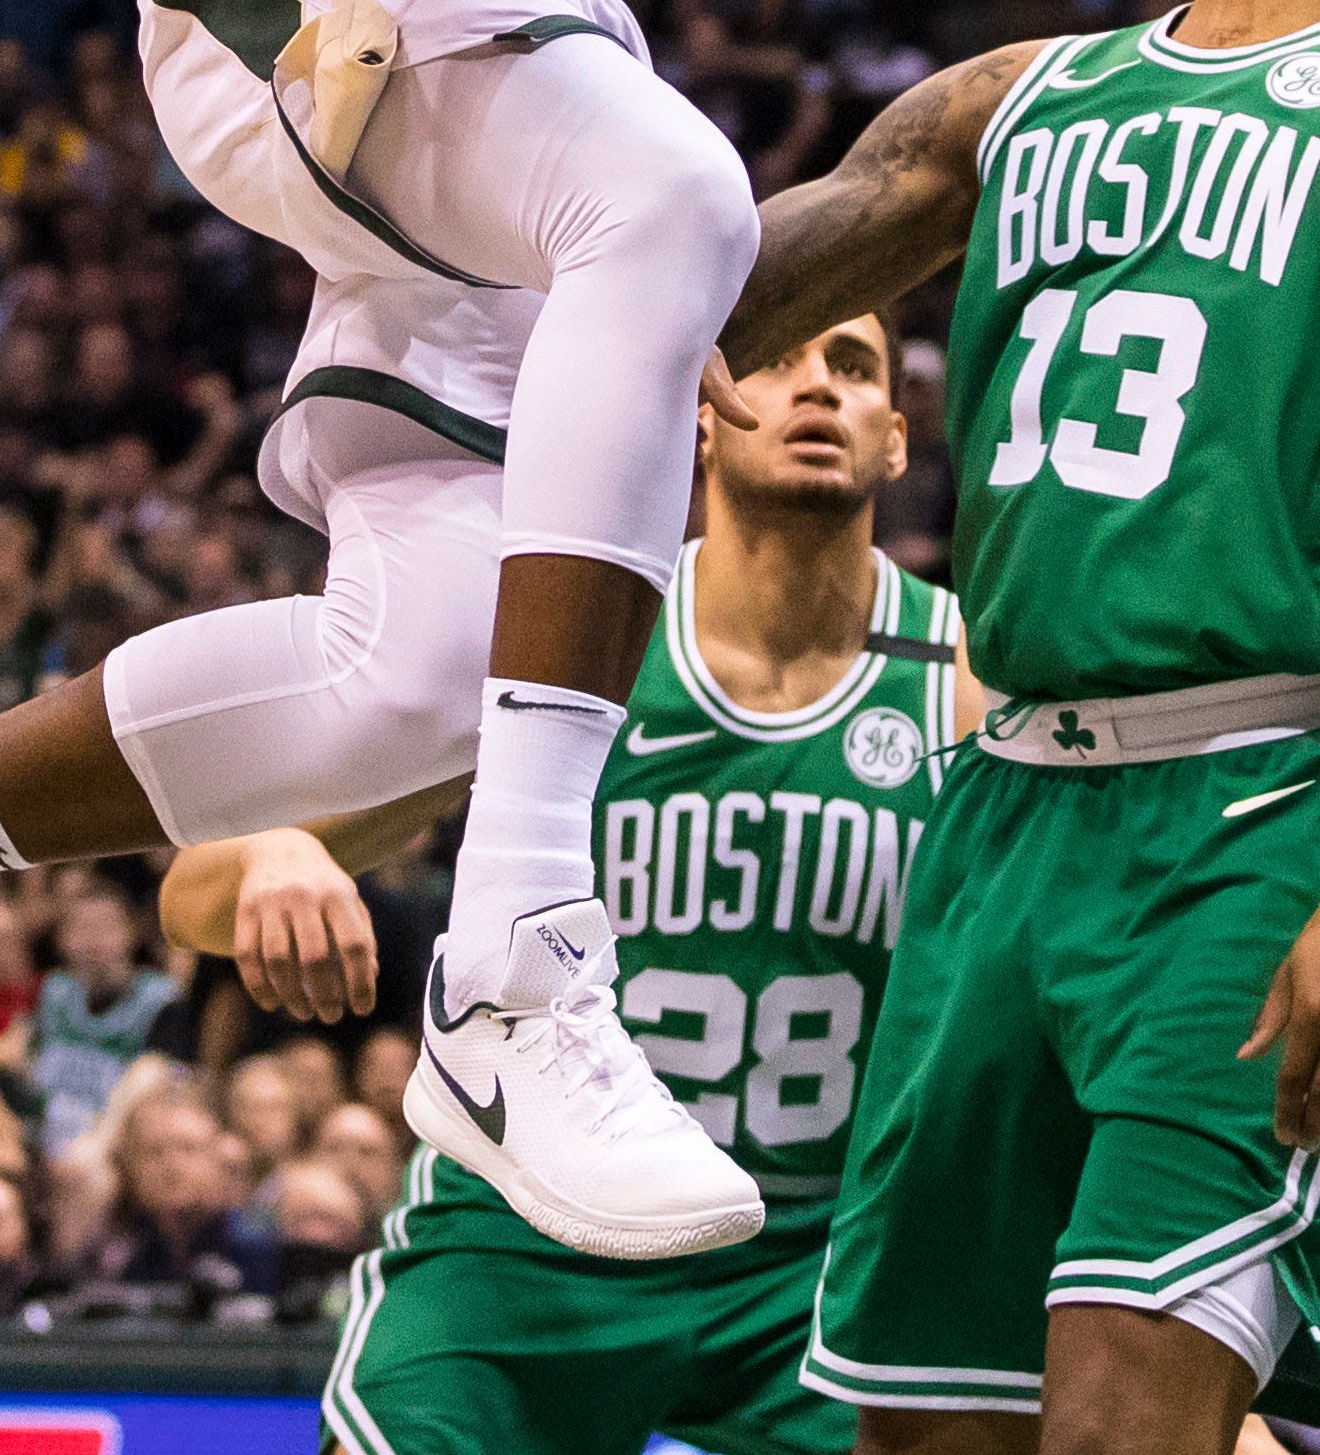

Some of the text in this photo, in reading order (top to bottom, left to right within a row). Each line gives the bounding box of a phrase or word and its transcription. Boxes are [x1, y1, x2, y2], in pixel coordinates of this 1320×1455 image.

[988, 289, 1208, 500] 13
[605, 792, 924, 949] BOSTON
[622, 967, 865, 1147] 28
